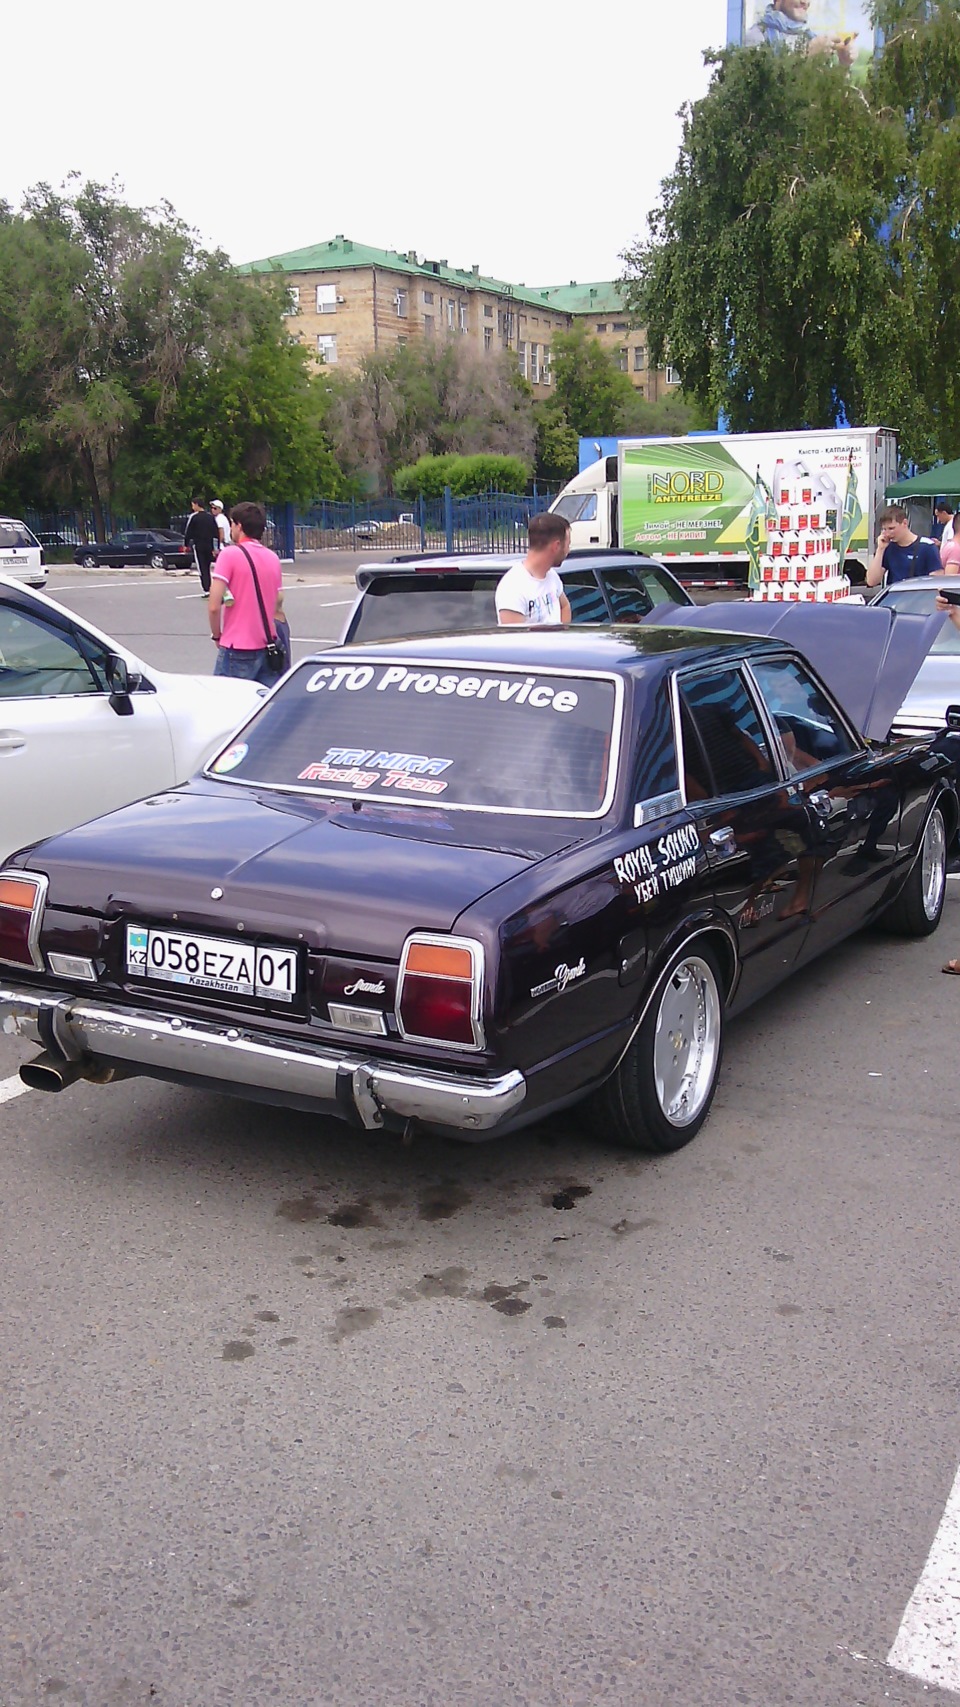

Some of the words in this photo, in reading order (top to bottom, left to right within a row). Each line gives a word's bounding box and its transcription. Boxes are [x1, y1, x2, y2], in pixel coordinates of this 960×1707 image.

[653, 471, 724, 495] NORD
[655, 493, 722, 503] ANTIFREEZE
[376, 667, 579, 712] Proservice
[297, 763, 380, 789] Racing
[381, 770, 448, 794] Team
[613, 845, 658, 883] ROYAL
[657, 823, 699, 865] SOUND
[634, 873, 660, 904] УБЕЙ
[660, 856, 696, 891] ТИШИНУ
[129, 950, 147, 964] KZ
[189, 976, 239, 992] Kazakhstan
